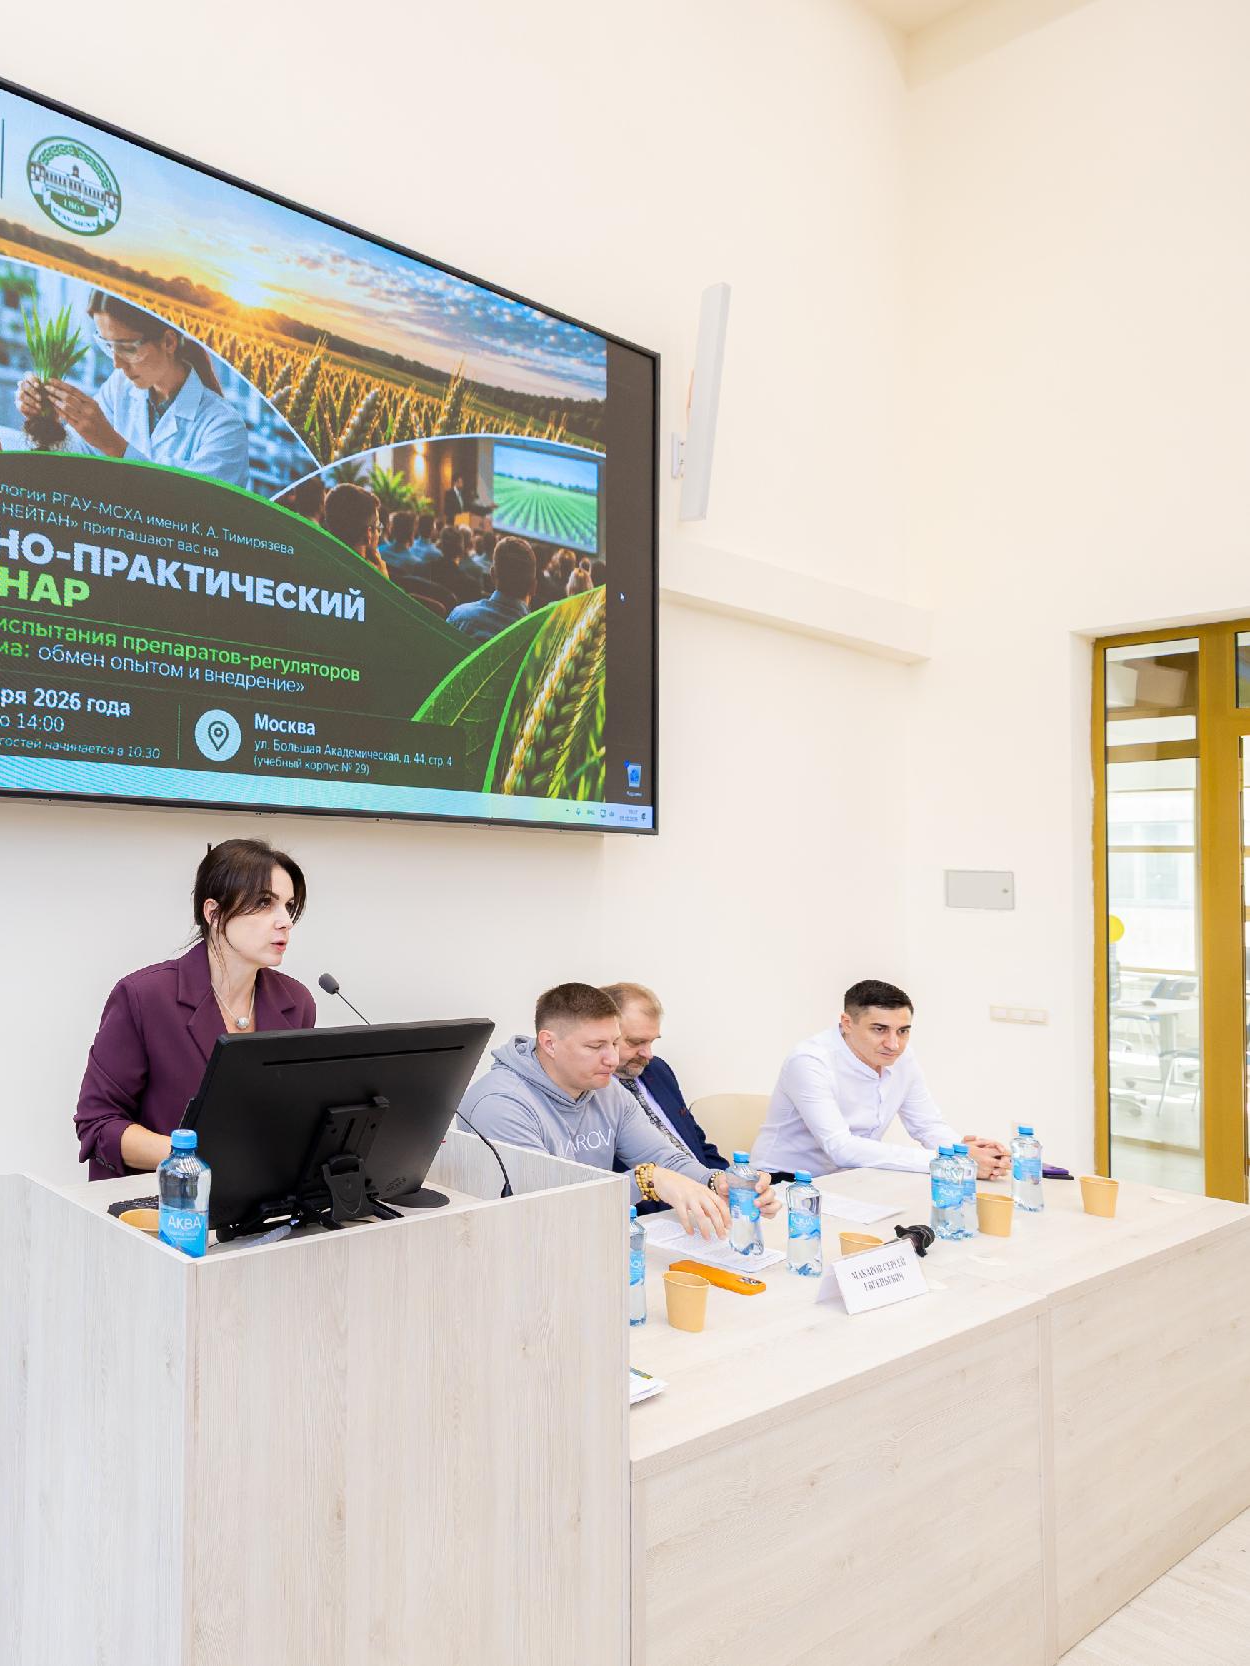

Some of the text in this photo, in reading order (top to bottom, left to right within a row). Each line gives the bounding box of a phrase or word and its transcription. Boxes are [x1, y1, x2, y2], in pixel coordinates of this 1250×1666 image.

[52, 491, 143, 523] РГАУ-МСХА
[146, 514, 188, 533] имени
[191, 522, 204, 536] К.
[222, 528, 294, 555] Тимирязева
[83, 520, 174, 548] приглашают
[178, 540, 200, 553] вас
[203, 545, 219, 557] на
[38, 644, 105, 667] обмен
[110, 656, 183, 678] опытом
[189, 669, 200, 681] и
[205, 669, 305, 693] внедрение»
[123, 634, 360, 682] препаратов-регуляторов
[34, 688, 81, 710] 2026
[86, 699, 131, 717] года
[17, 712, 65, 732] 14:00
[254, 712, 316, 736] Москва
[0, 736, 42, 750] гостей
[44, 742, 115, 756] начинается
[128, 745, 161, 760] 10.30
[254, 739, 402, 763] ул. Большая Академическая,
[253, 755, 339, 774] (учебный корпус
